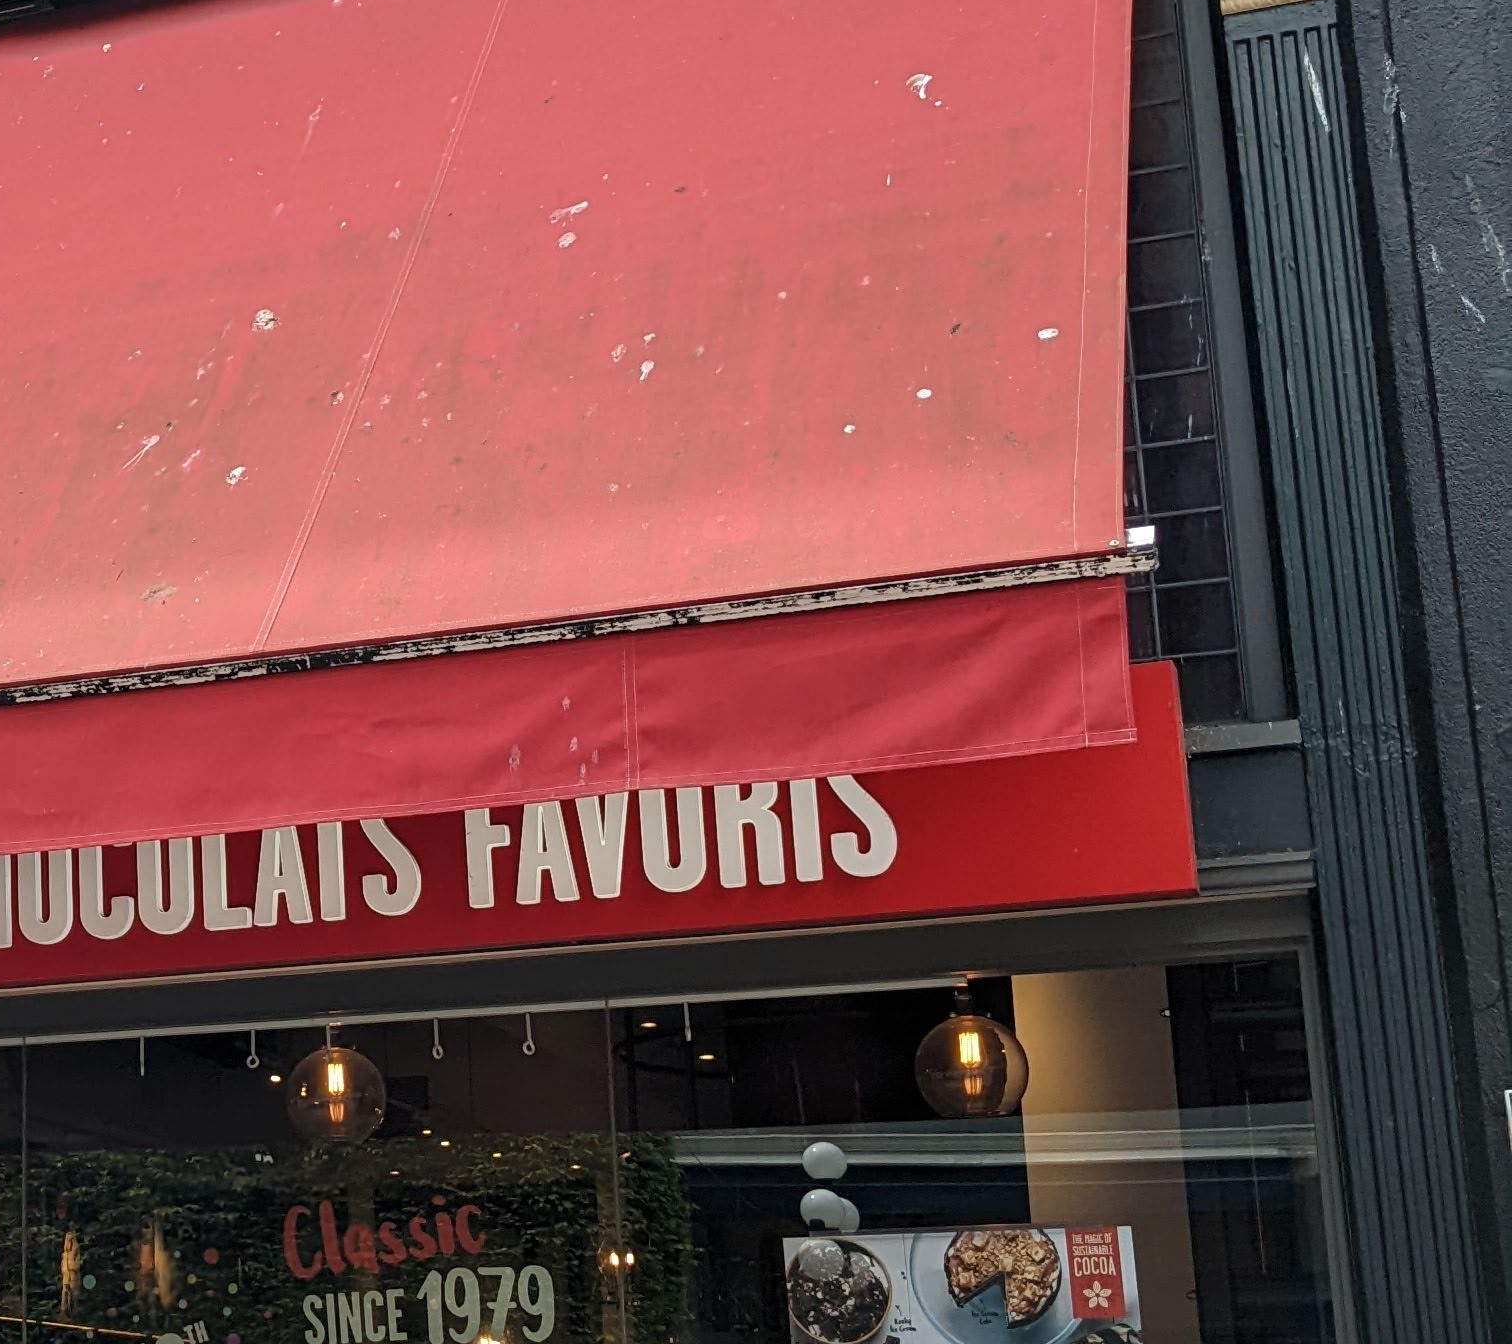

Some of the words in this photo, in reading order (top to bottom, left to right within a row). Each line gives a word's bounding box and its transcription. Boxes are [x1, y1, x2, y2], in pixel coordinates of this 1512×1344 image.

[463, 773, 899, 910] FAVORIS
[282, 1194, 488, 1281] Classic
[1104, 1232, 1113, 1243] OF
[1073, 1256, 1117, 1277] COCOA
